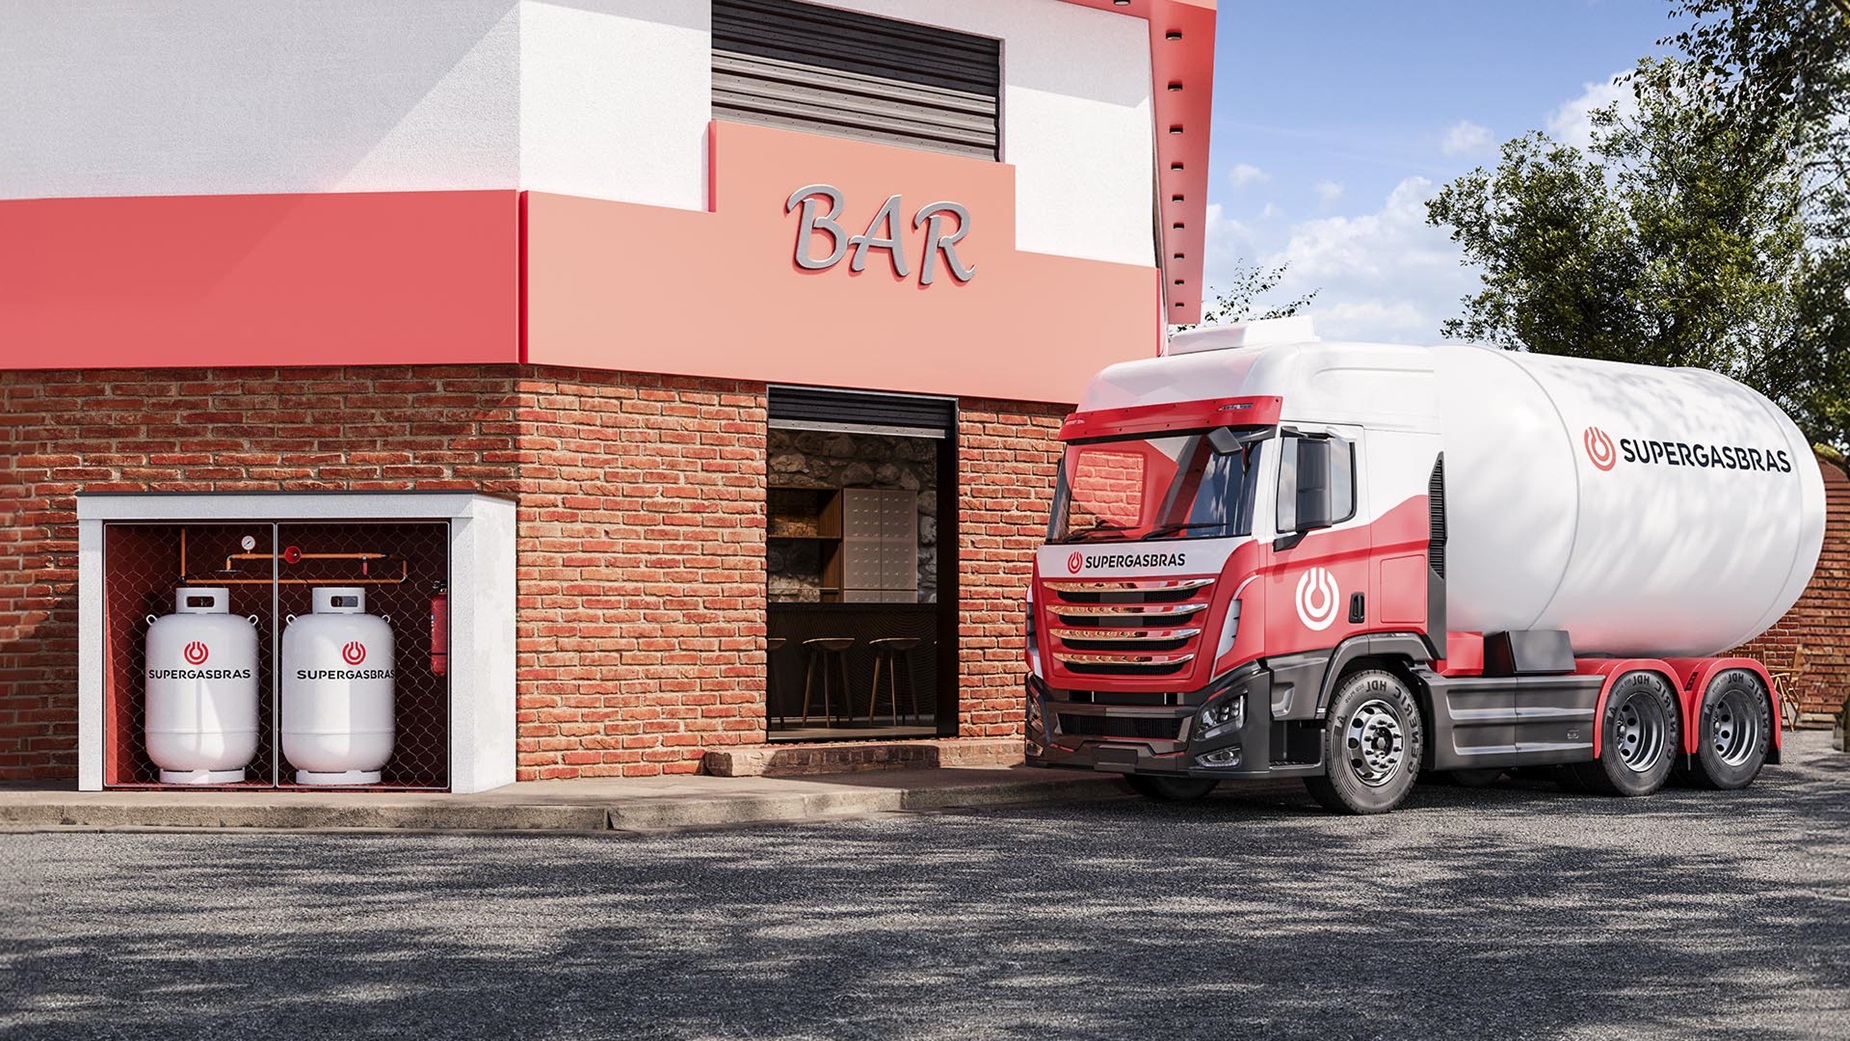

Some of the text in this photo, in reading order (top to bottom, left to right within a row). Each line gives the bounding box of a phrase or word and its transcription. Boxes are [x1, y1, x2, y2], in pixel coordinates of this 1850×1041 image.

[786, 184, 976, 286] BAR
[1620, 438, 1792, 473] SUPERGASBRAS
[1085, 553, 1186, 569] SUPERGASBRAS
[148, 669, 251, 680] SUPERGASBRAS
[296, 669, 395, 680] SUPERGASBRAS
